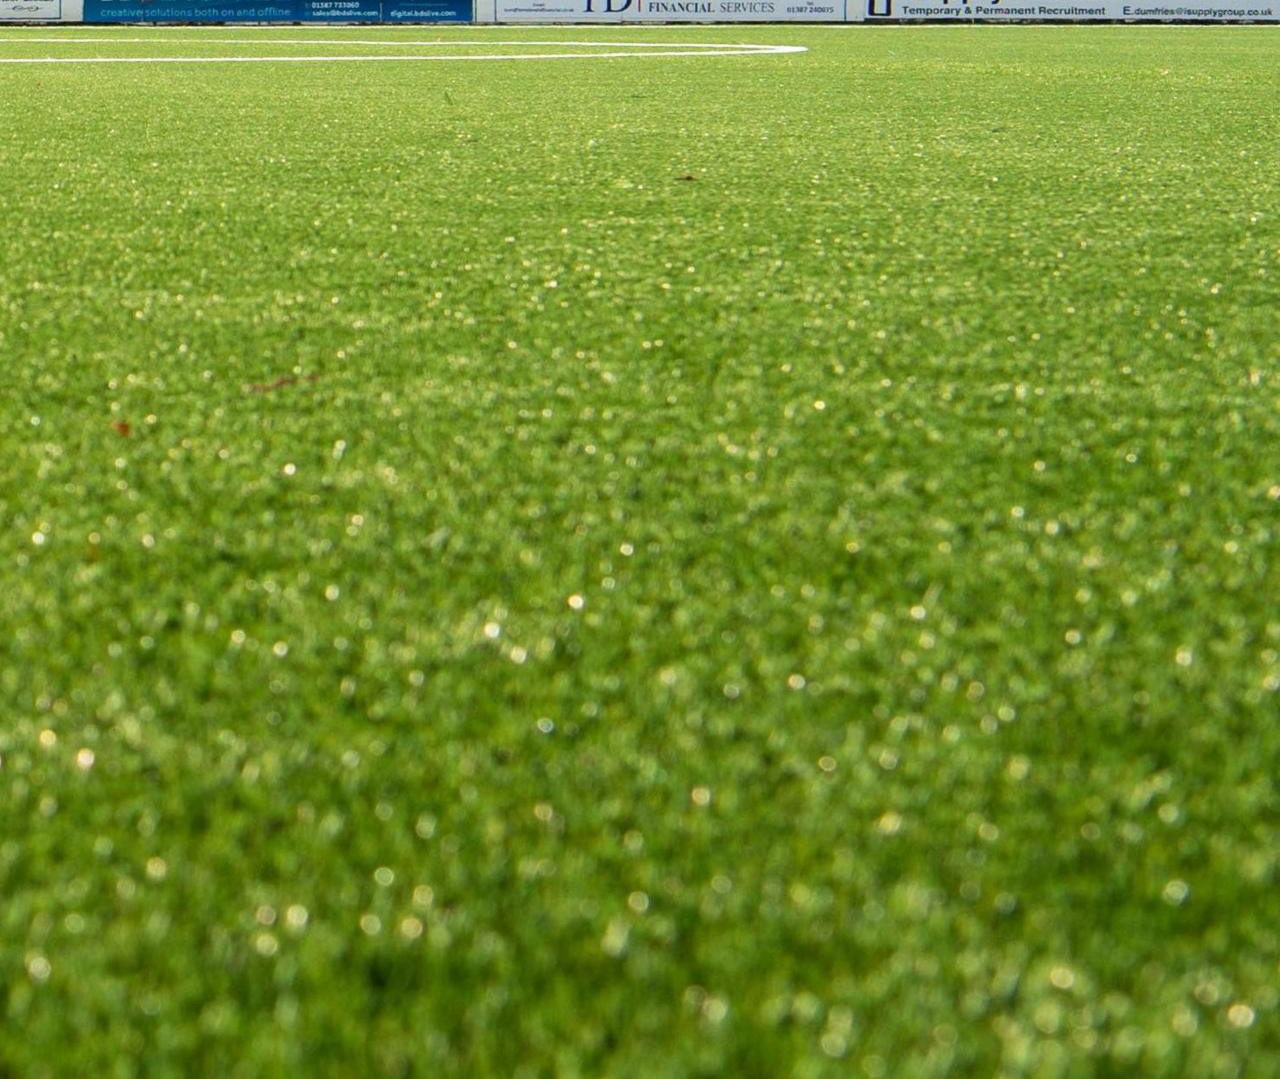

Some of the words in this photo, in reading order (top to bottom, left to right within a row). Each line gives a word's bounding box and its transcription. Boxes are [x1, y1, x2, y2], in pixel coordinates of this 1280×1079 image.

[100, 8, 141, 17] creative
[145, 8, 191, 17] solutions
[195, 8, 219, 17] both
[221, 9, 234, 17] on
[237, 8, 255, 17] and
[257, 7, 291, 17] offline
[648, 1, 716, 14] FINANCIAL
[720, 1, 775, 14] SERVICES
[902, 6, 961, 16] Temporary
[964, 6, 972, 15] &
[975, 6, 1037, 15] Permanent
[1039, 6, 1106, 15] Recruitment
